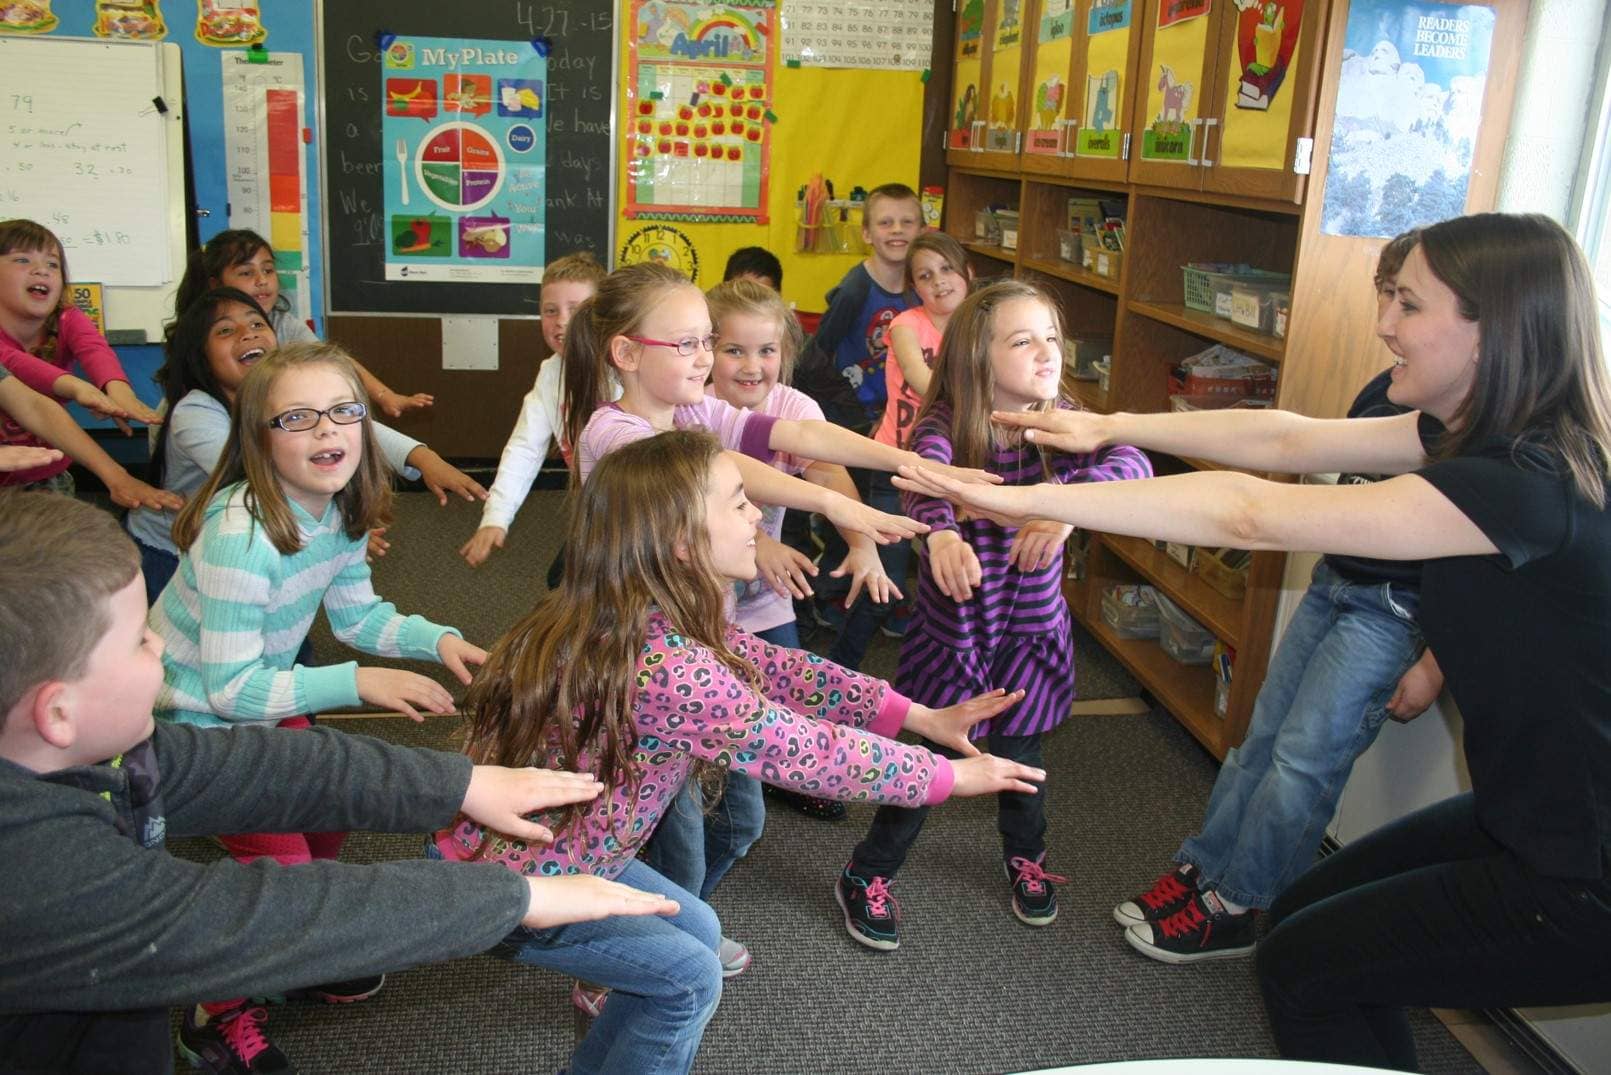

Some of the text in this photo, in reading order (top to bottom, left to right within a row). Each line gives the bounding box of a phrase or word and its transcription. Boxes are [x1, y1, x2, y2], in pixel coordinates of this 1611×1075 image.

[818, 6, 828, 15] 73
[864, 9, 874, 17] 76
[893, 10, 904, 18] 78
[801, 22, 812, 31] 82
[816, 23, 828, 31] 83
[831, 24, 842, 32] 84
[847, 24, 858, 32] 85
[907, 27, 918, 35] 89
[1417, 16, 1470, 33] READERS
[801, 38, 812, 46] 92
[817, 39, 827, 47] 93
[862, 41, 873, 49] 96
[876, 41, 888, 49] 97
[891, 42, 902, 50] 98
[1415, 30, 1469, 47] BECOME
[671, 32, 729, 59] April
[1413, 43, 1466, 60] LEADERS
[421, 47, 520, 70] MyPlate
[547, 47, 596, 80] oday
[582, 86, 602, 100] is
[644, 233, 650, 244] 11
[656, 230, 665, 241] 12
[683, 246, 690, 257] 2
[687, 260, 693, 272] 3
[75, 288, 91, 299] 50
